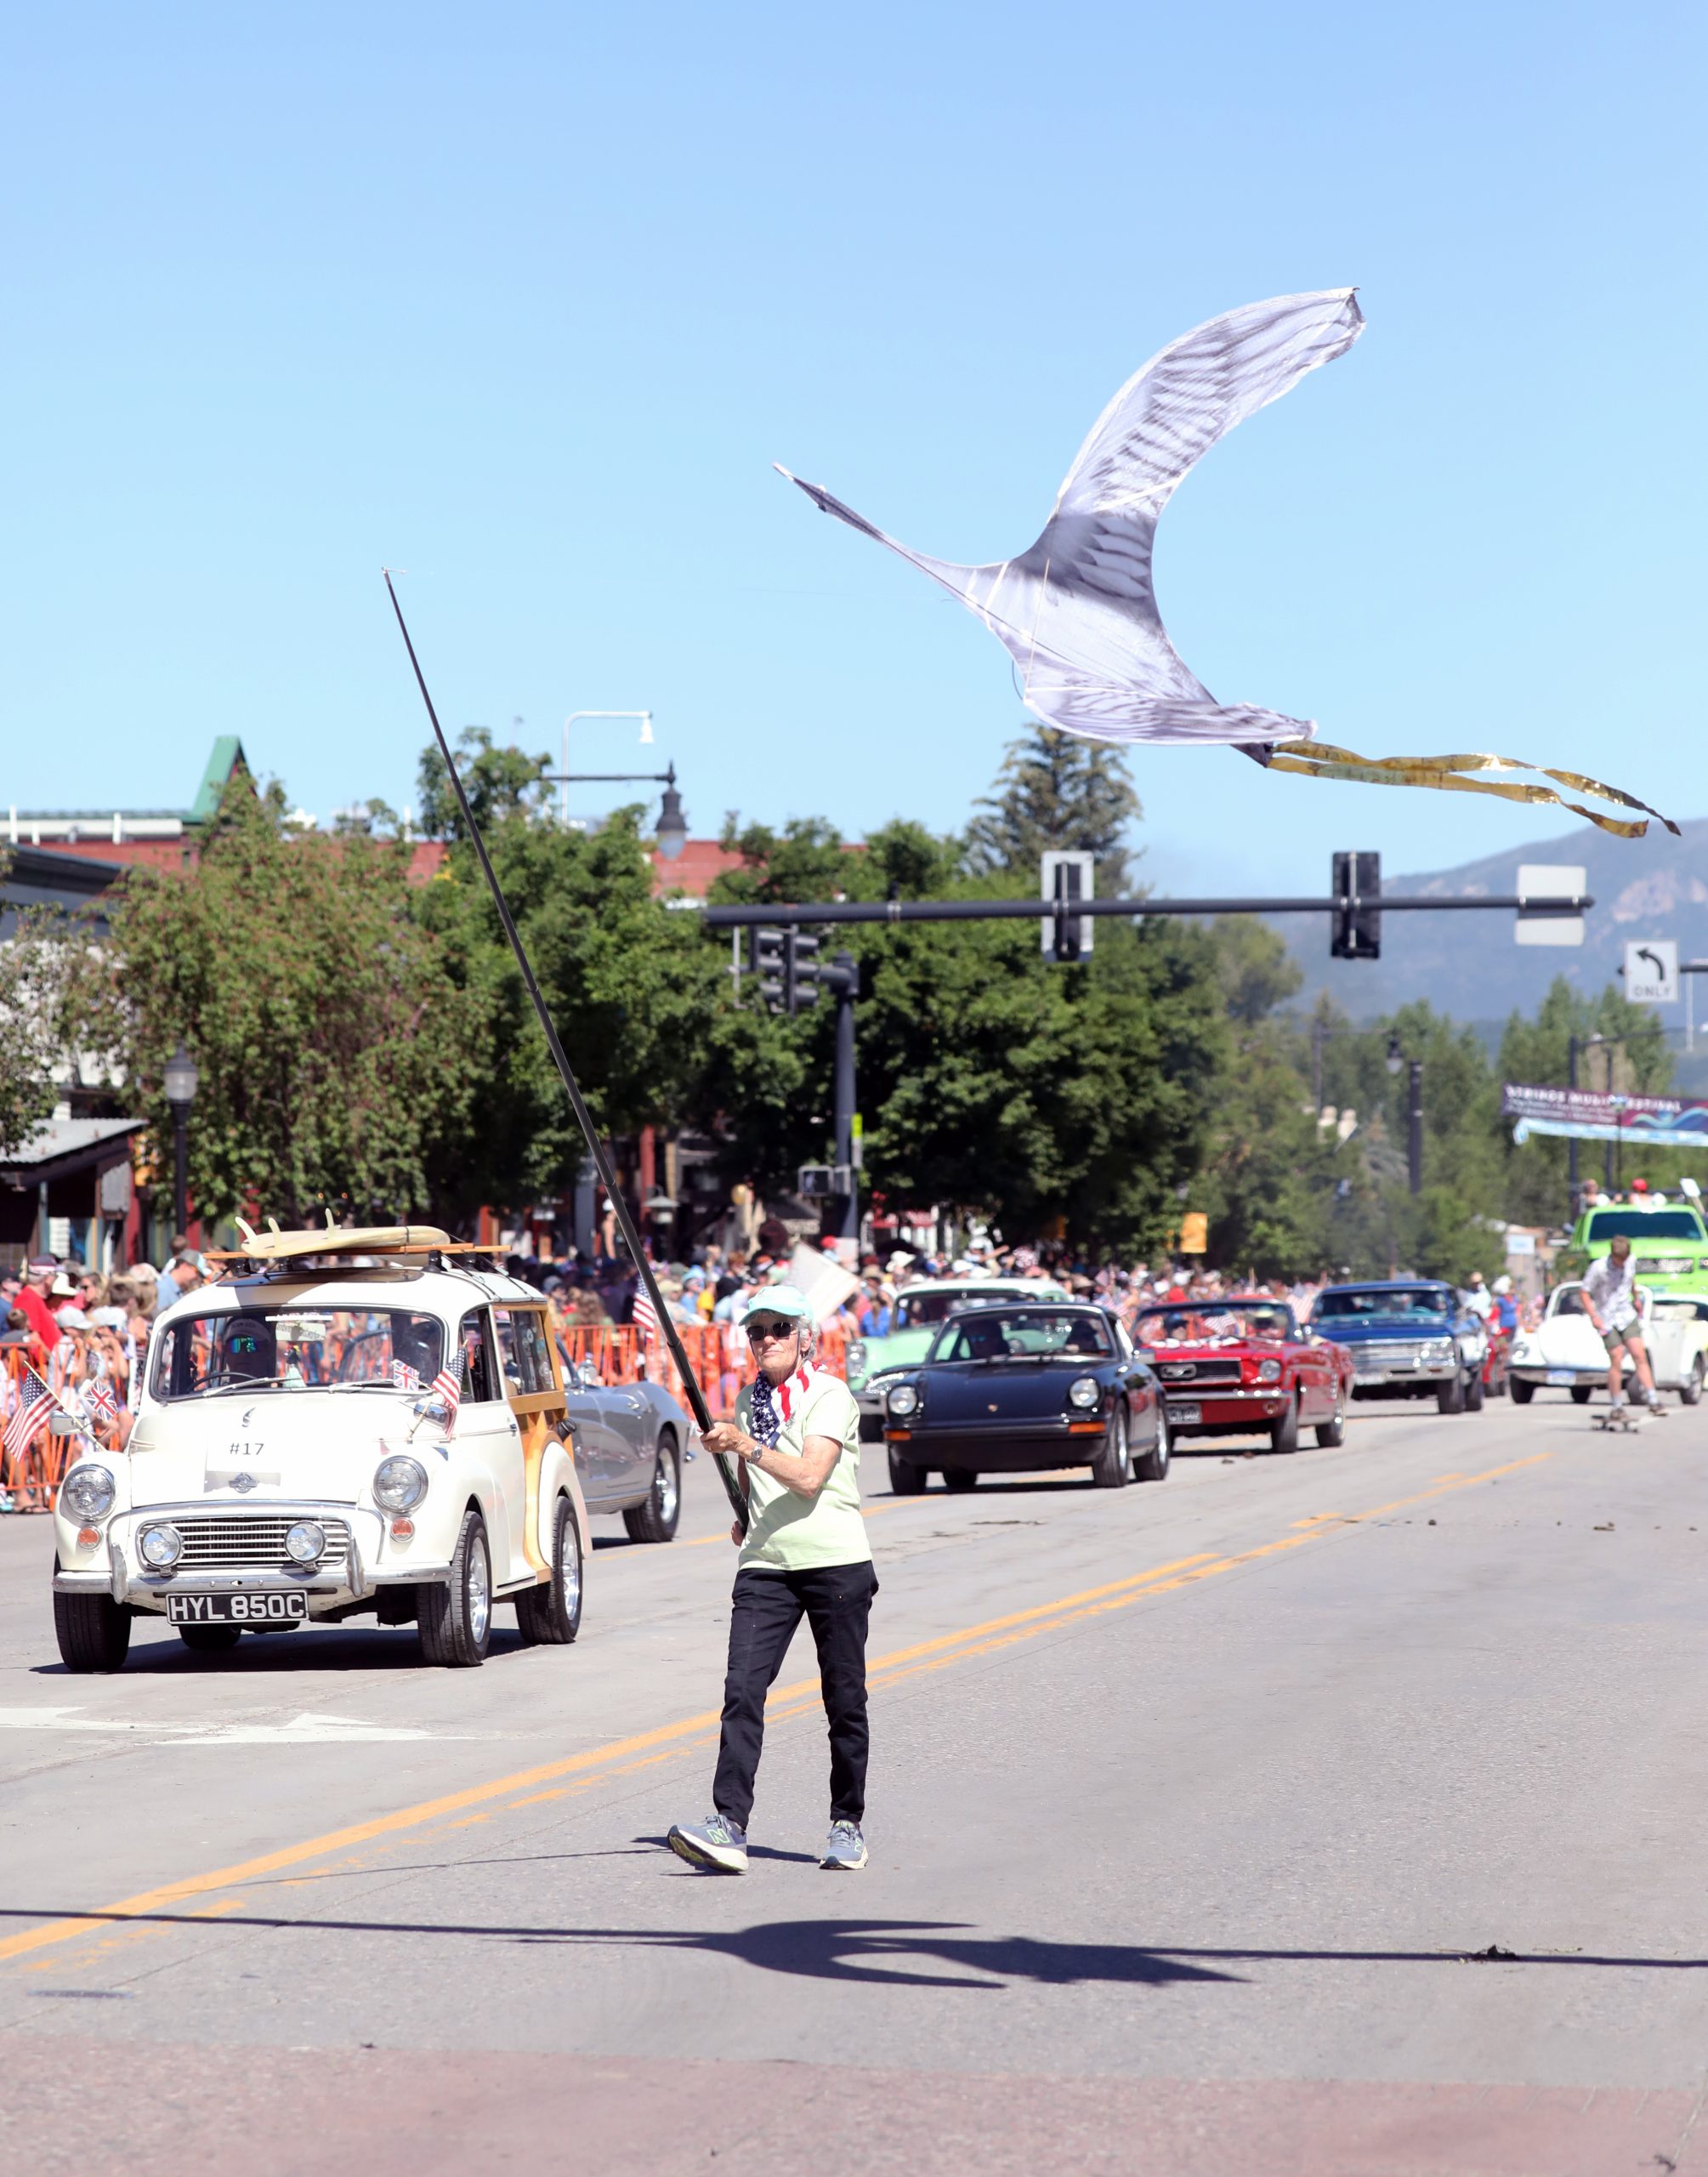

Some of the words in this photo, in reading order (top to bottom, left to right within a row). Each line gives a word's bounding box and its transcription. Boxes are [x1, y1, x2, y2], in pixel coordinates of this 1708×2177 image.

[1634, 986, 1672, 998] ONLY
[1619, 1094, 1681, 1113] ESTIVAL
[230, 1442, 264, 1456] #17
[170, 1596, 225, 1620] HYL
[230, 1594, 304, 1619] 850C
[706, 1827, 731, 1844] N
